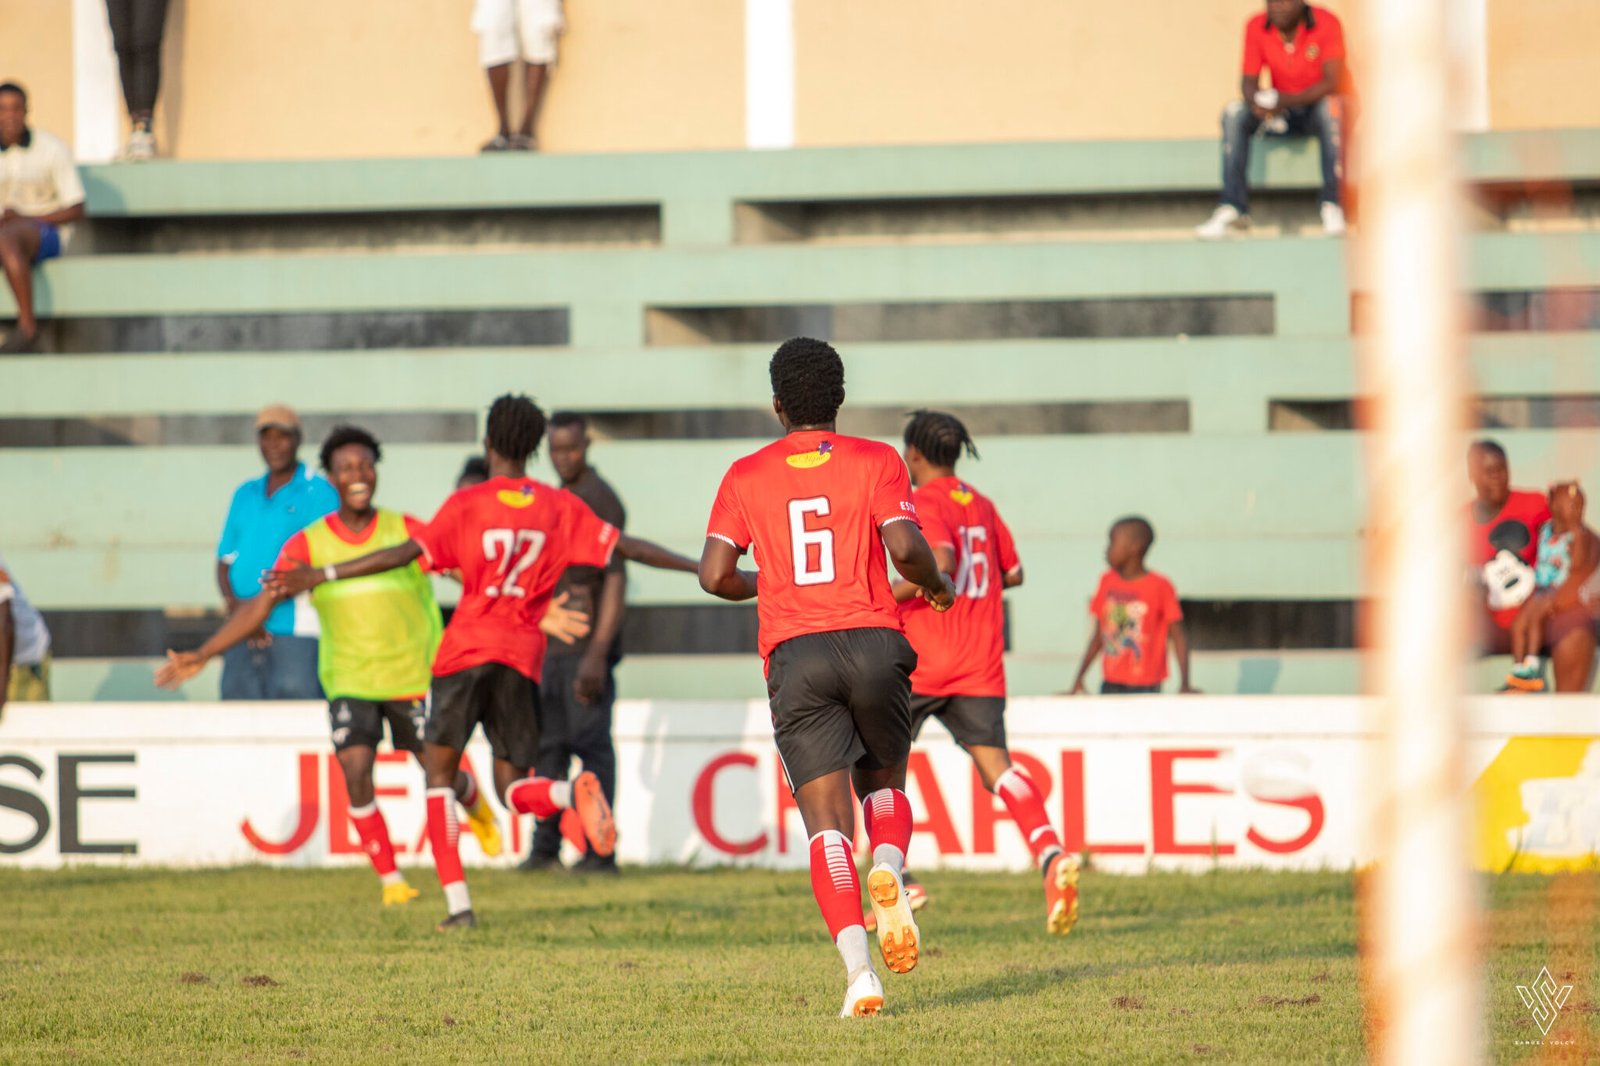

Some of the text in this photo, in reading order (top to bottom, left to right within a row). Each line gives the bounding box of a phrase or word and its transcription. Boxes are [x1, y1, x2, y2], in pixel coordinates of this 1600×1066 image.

[482, 528, 546, 598] 22
[788, 496, 836, 587] 6
[956, 525, 989, 598] 16
